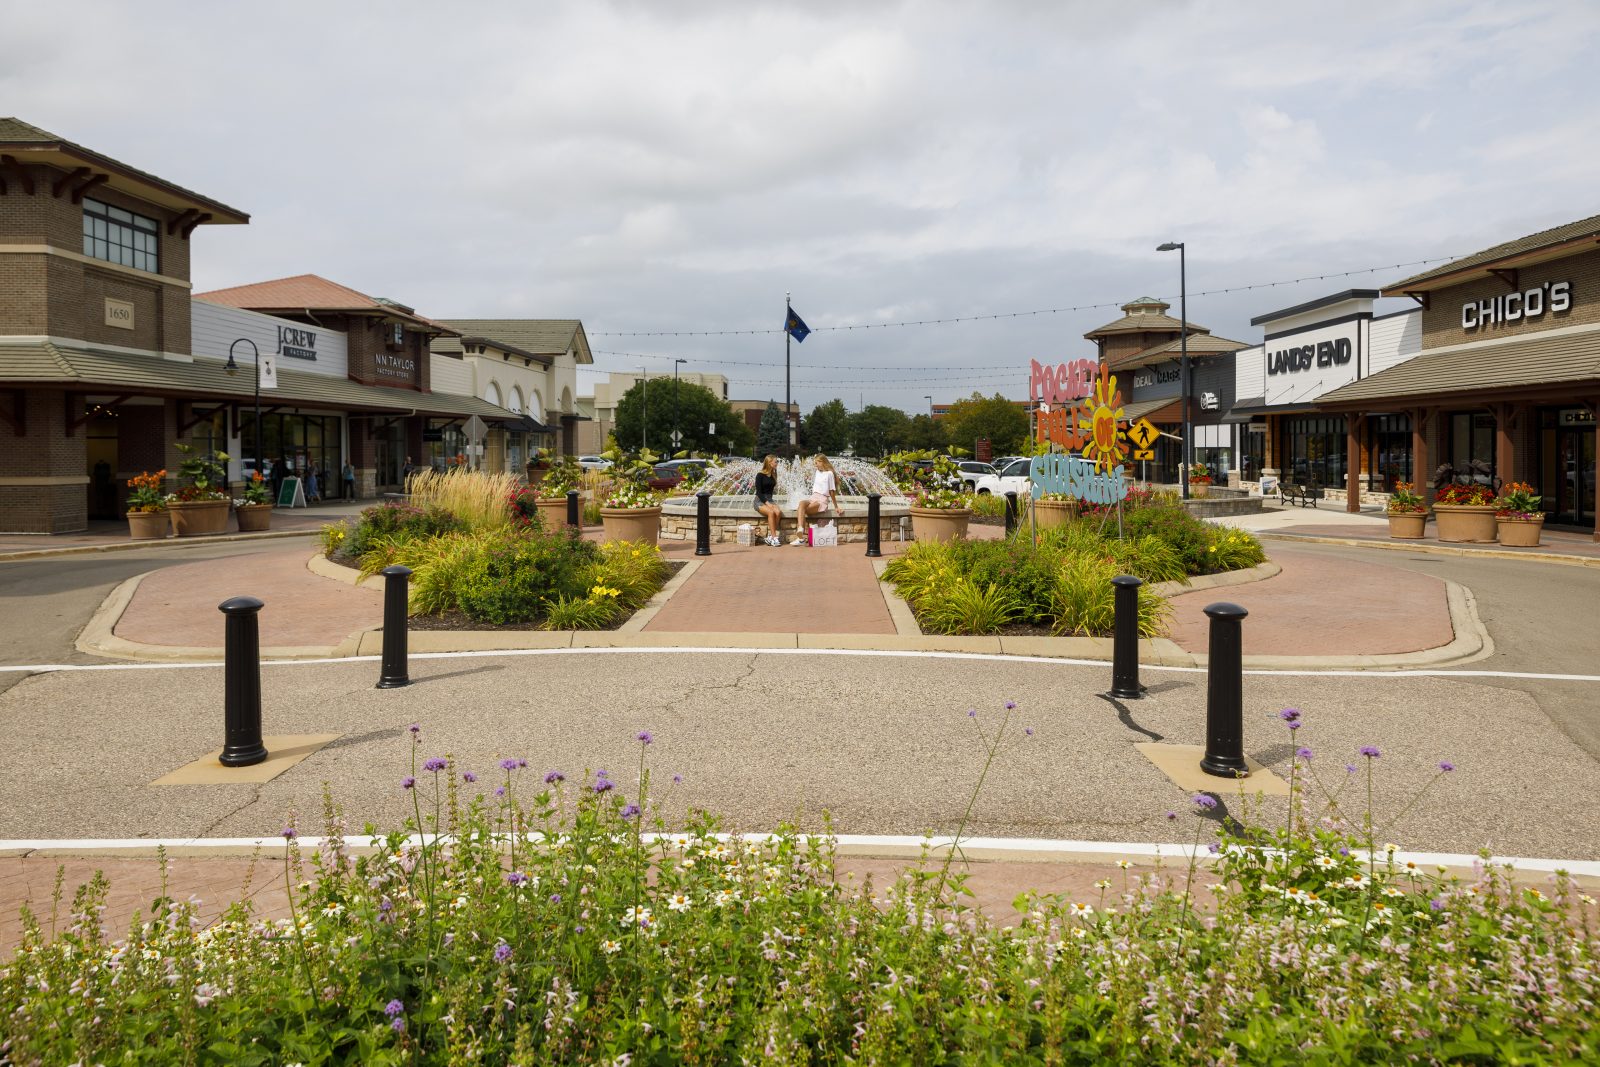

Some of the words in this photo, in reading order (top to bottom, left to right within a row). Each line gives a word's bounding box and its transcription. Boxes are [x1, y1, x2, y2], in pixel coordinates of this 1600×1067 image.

[109, 307, 130, 320] 1650
[1462, 281, 1570, 328] CHICO'S
[276, 325, 316, 354] J.CREW
[389, 355, 415, 371] TAYLOR
[1267, 344, 1316, 375] LANDS'
[1316, 337, 1352, 367] END
[1030, 358, 1099, 405] POCKET
[1133, 375, 1153, 388] IDEAL
[1036, 406, 1085, 450] FULL
[1096, 416, 1114, 447] OF
[813, 537, 836, 546] LOFT
